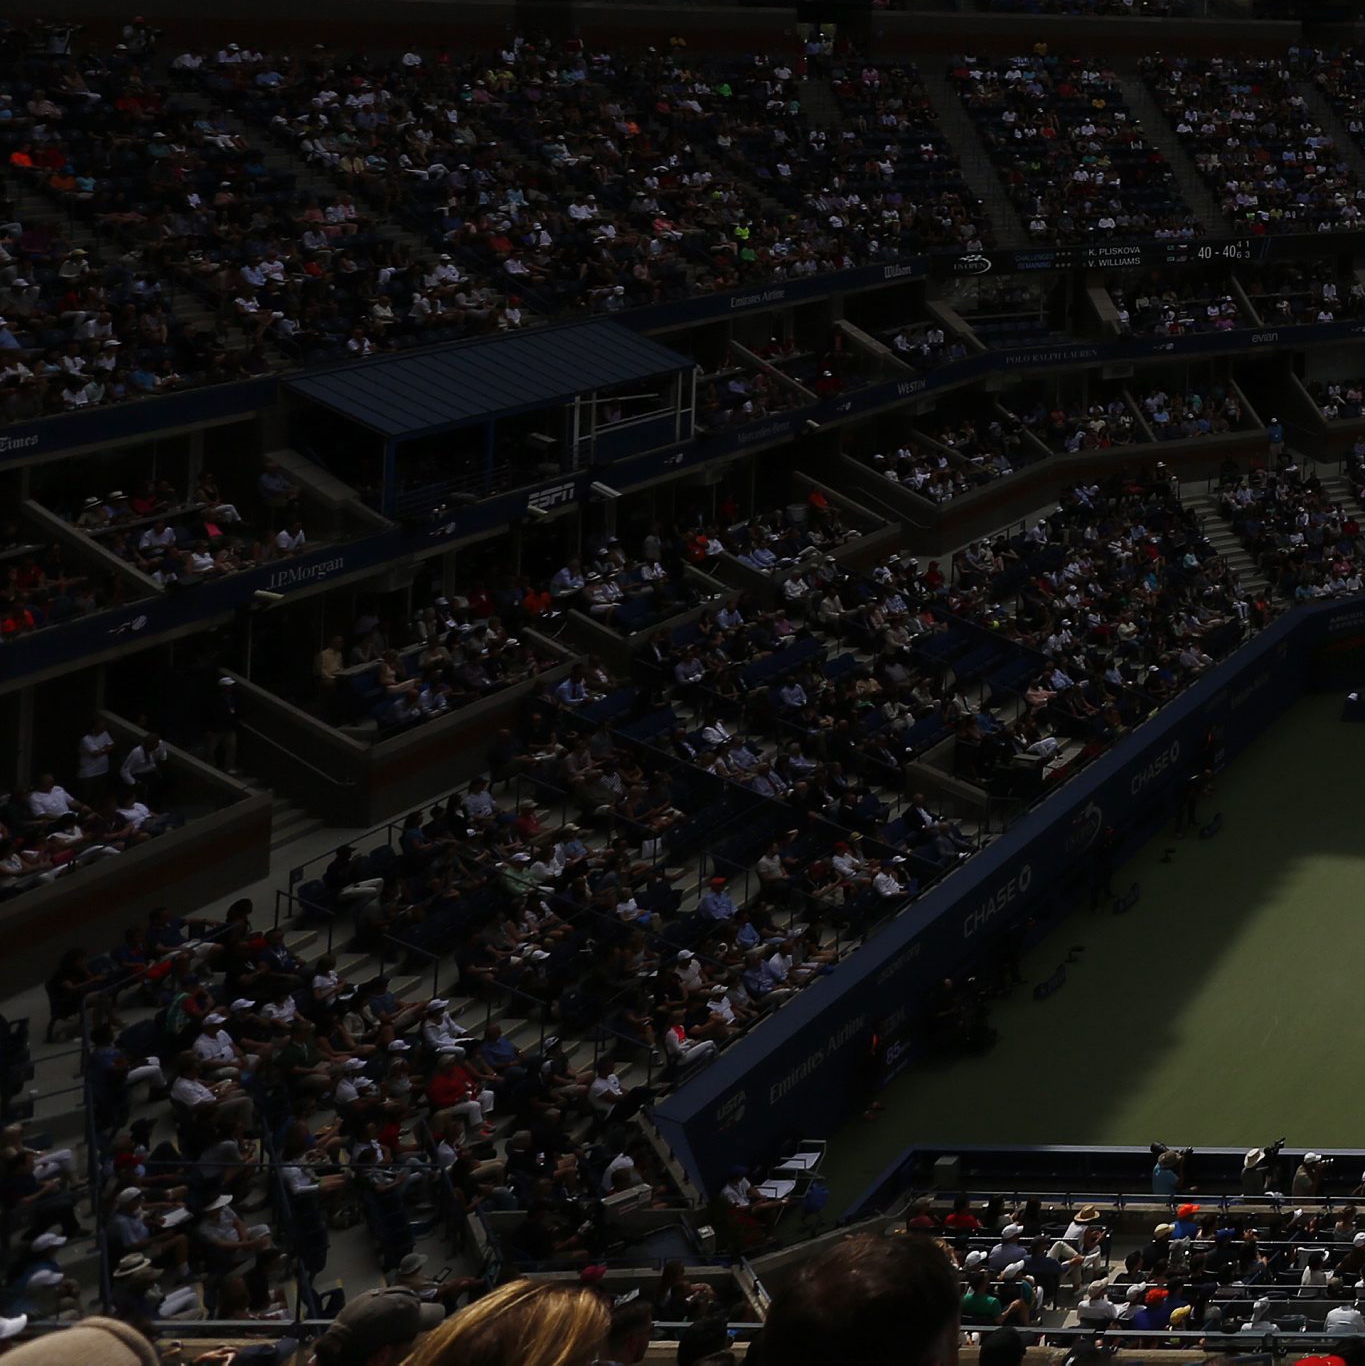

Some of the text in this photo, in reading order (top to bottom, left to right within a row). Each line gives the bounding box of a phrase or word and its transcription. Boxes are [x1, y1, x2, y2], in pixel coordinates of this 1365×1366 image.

[1098, 246, 1142, 256] PLISKOVA
[1198, 245, 1212, 260] 40
[1222, 244, 1236, 259] 40
[1098, 257, 1142, 267] WILLIAMS
[730, 293, 761, 310] Emirates
[1251, 331, 1279, 343] evian
[1005, 354, 1032, 365] POLO
[1063, 348, 1099, 361] LAUREN
[267, 555, 345, 590] J.P.Morgan
[1131, 748, 1170, 795] CHASE
[963, 875, 1016, 938] CHASE
[769, 1047, 825, 1106] Emirates
